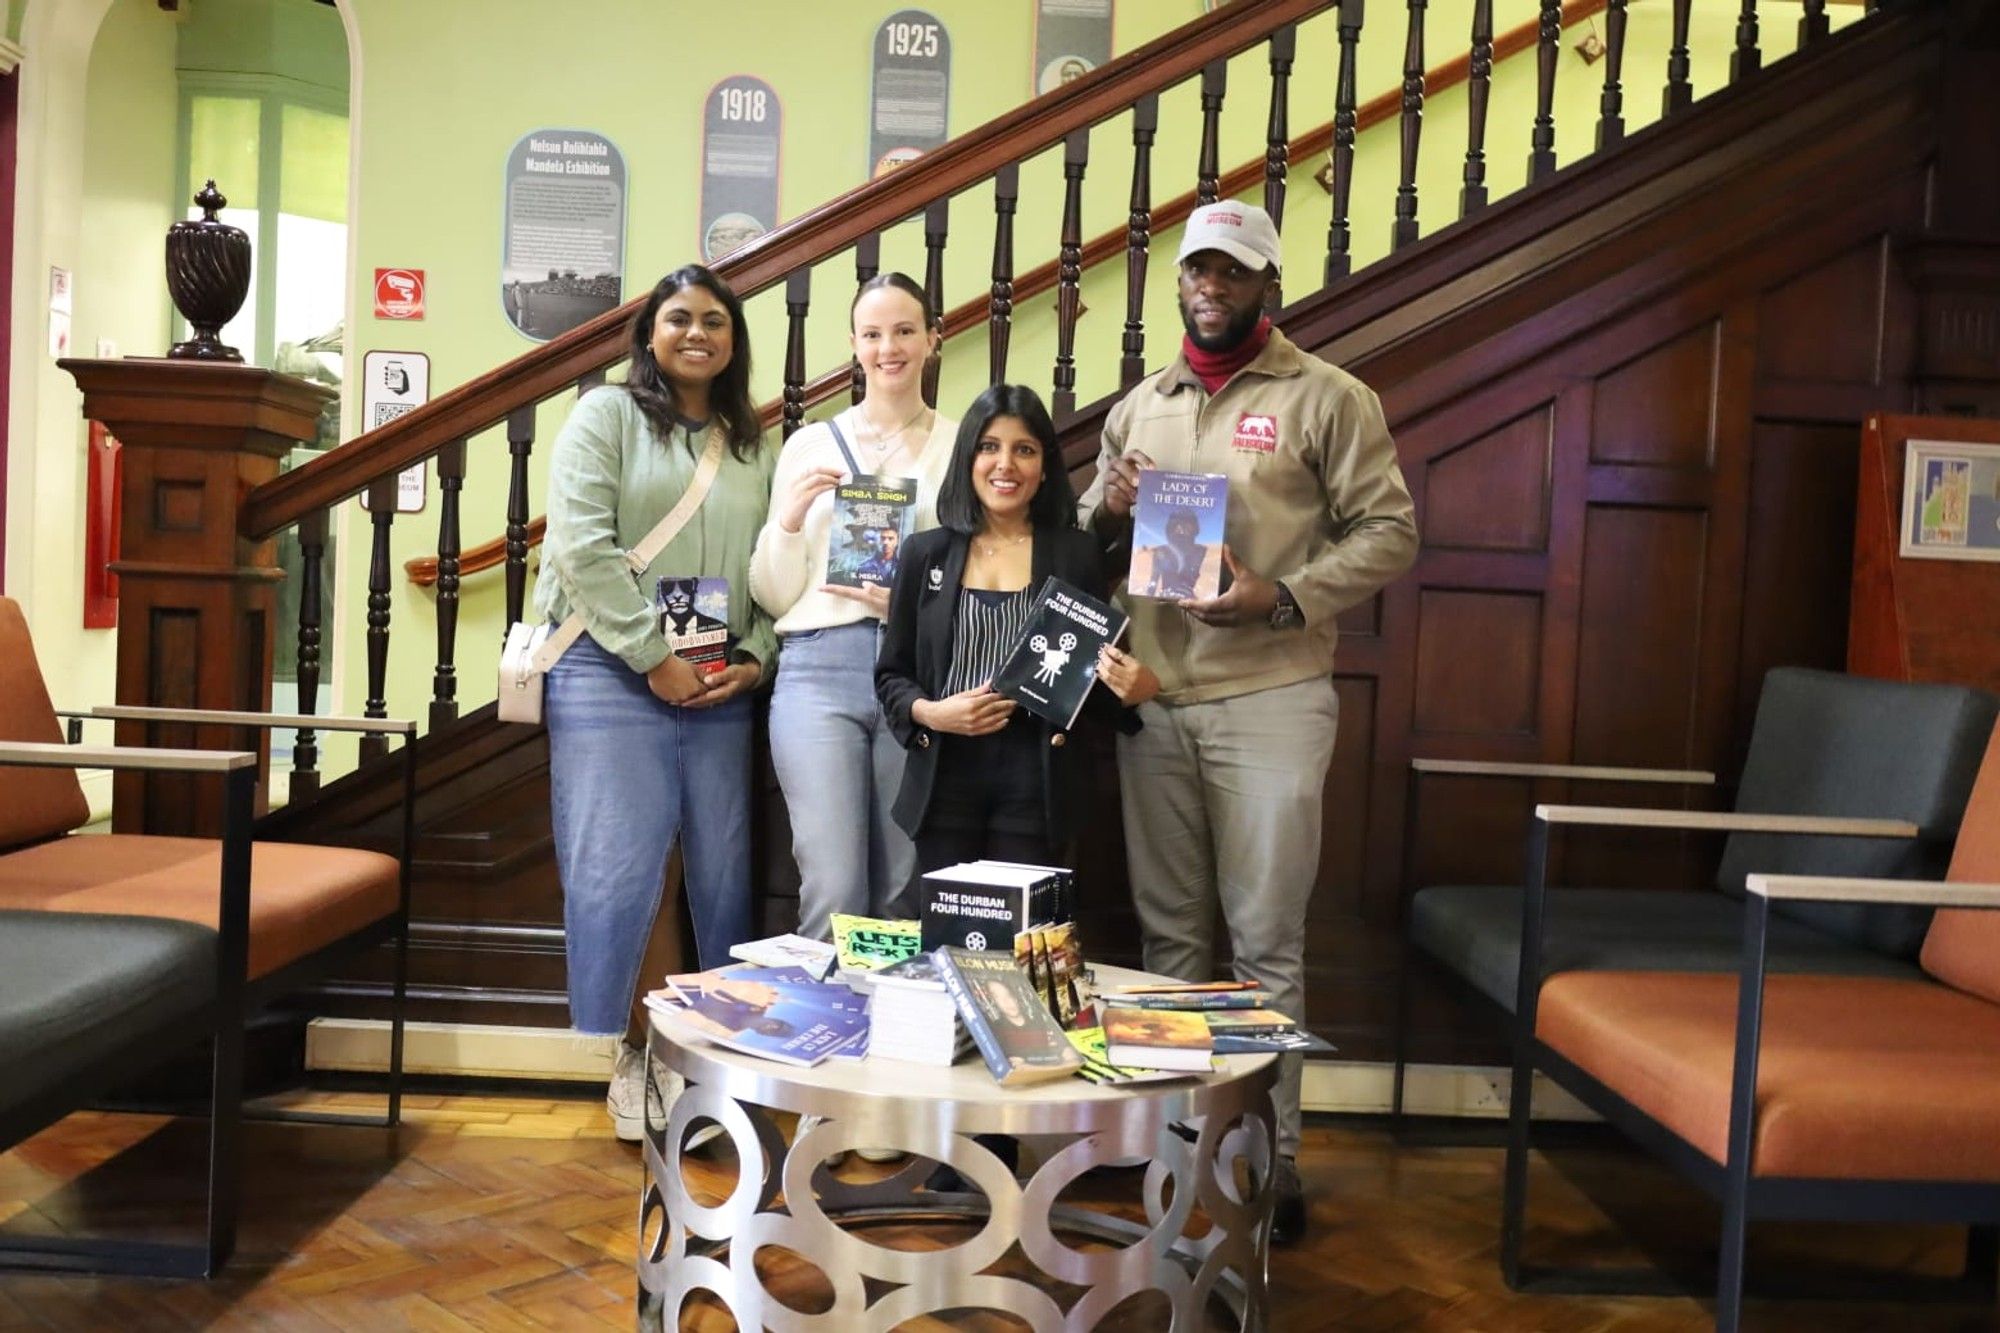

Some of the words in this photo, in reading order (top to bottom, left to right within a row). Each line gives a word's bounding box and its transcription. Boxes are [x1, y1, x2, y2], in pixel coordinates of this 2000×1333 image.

[886, 22, 938, 57] 1925
[720, 87, 767, 122] 1918
[530, 139, 561, 154] Nelson
[526, 158, 564, 174] Mandela
[565, 160, 610, 176] Exhibition
[841, 488, 873, 500] SIMBA
[877, 490, 908, 503] SINGH
[1162, 482, 1191, 493] LADY
[1193, 483, 1209, 494] OF
[1153, 493, 1174, 504] THE
[1176, 494, 1215, 508] DESERT
[1055, 591, 1071, 606] THE
[1072, 600, 1109, 626] DURBAN
[1045, 598, 1069, 617] FOUR
[1067, 608, 1110, 637] HUNDRED
[938, 892, 959, 905] THE
[960, 894, 1006, 910] DURBAN
[930, 902, 959, 915] FOUR
[960, 905, 1013, 921] HUNDRED
[855, 931, 919, 947] LETS
[852, 942, 899, 959] ROCK
[984, 959, 1018, 972] MUSK
